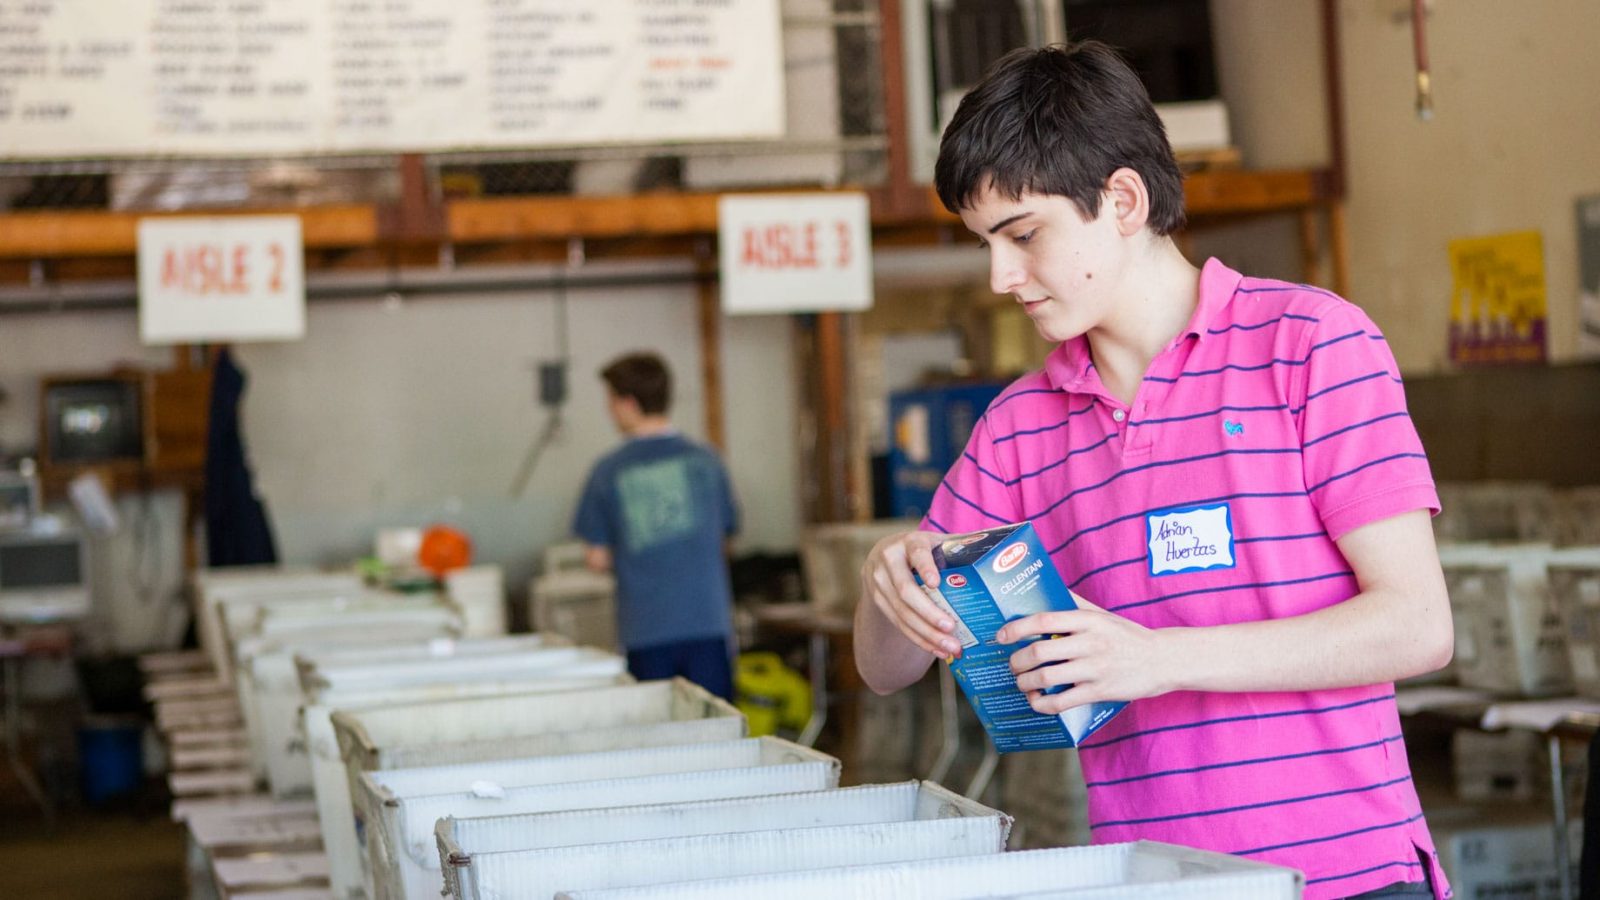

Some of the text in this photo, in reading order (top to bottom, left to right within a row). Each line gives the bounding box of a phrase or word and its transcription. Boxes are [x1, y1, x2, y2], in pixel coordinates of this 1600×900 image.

[739, 219, 853, 270] AISLE 3
[159, 240, 286, 295] AISLE 2
[1155, 520, 1192, 541] Adrian
[999, 544, 1026, 568] Barilla
[1166, 537, 1217, 561] Huertas
[1000, 559, 1043, 594] CELLENTANI
